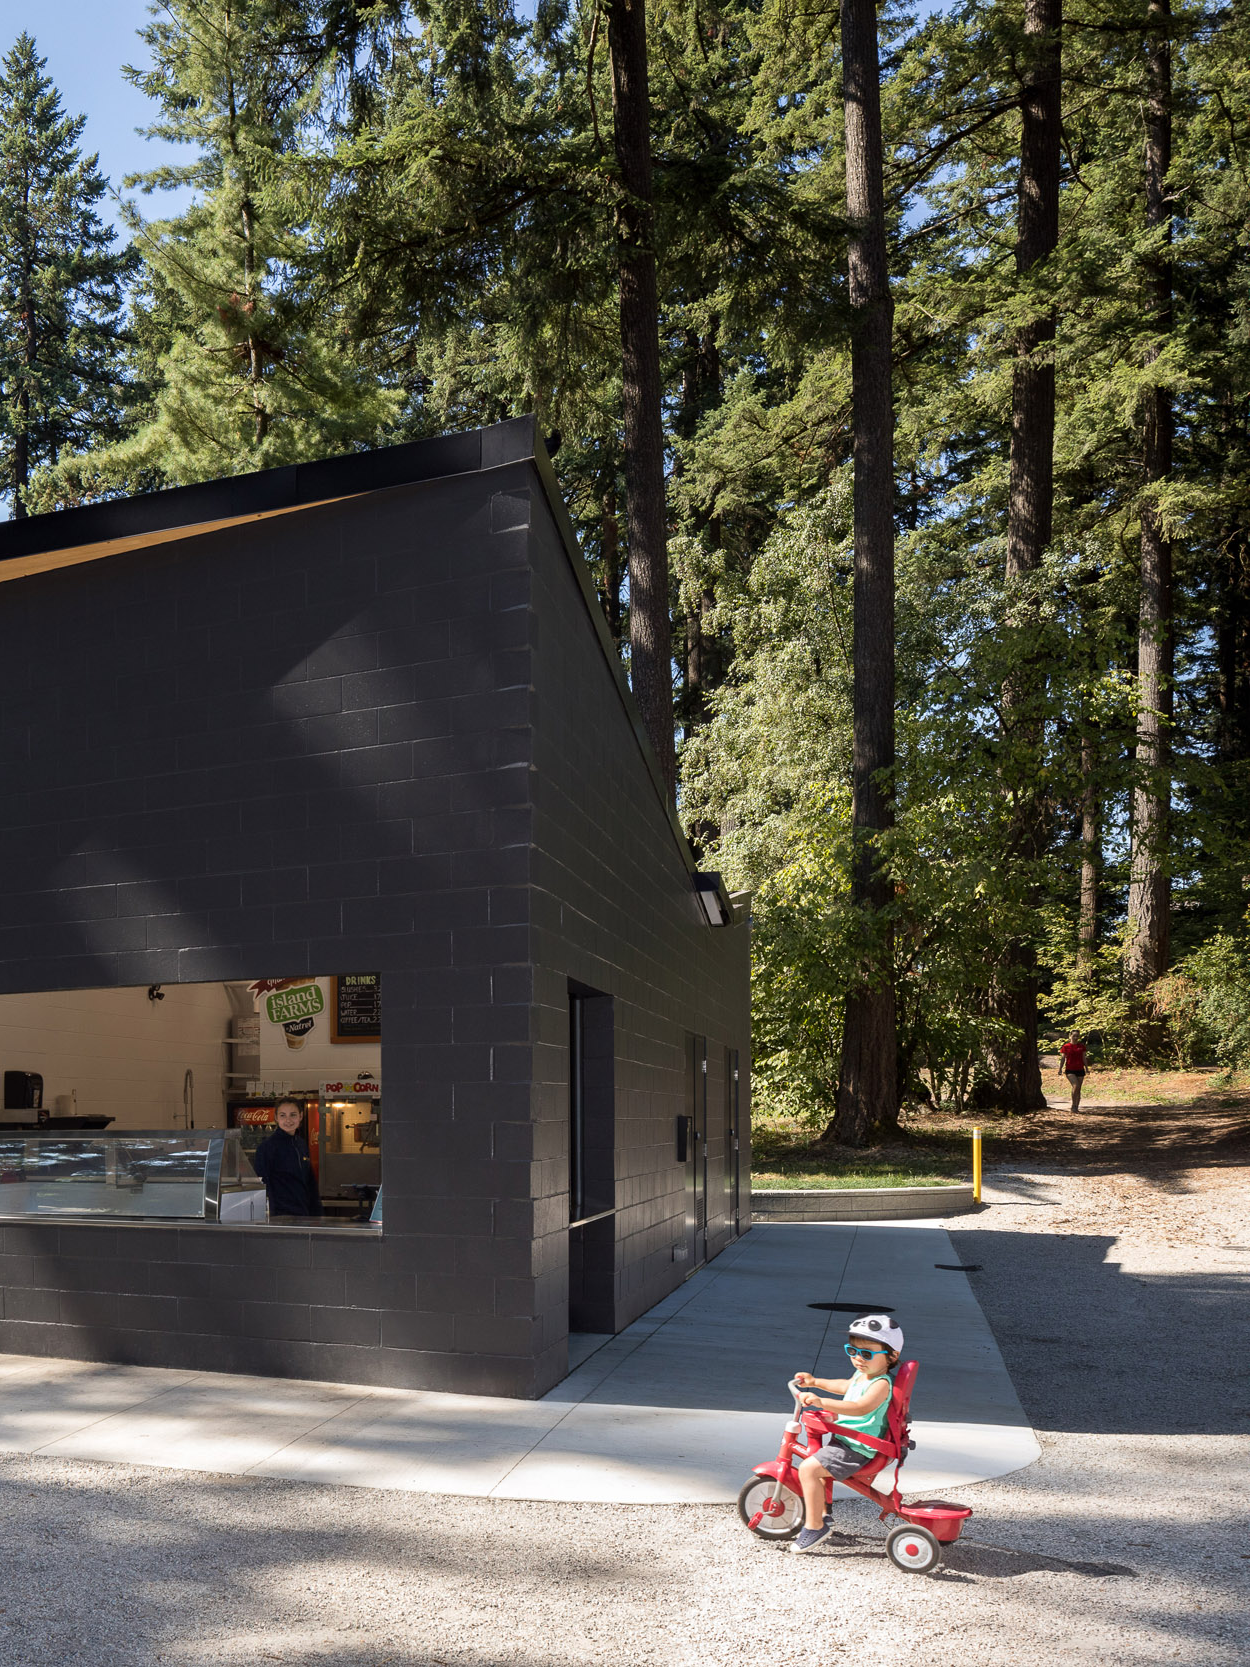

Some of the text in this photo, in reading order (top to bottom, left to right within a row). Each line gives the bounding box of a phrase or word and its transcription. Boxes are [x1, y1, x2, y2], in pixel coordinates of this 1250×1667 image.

[345, 976, 376, 986] DRINKS
[271, 986, 317, 1009] island
[271, 999, 321, 1021] FARMS
[288, 1020, 312, 1032] Natrel
[326, 1082, 379, 1093] POP CORN
